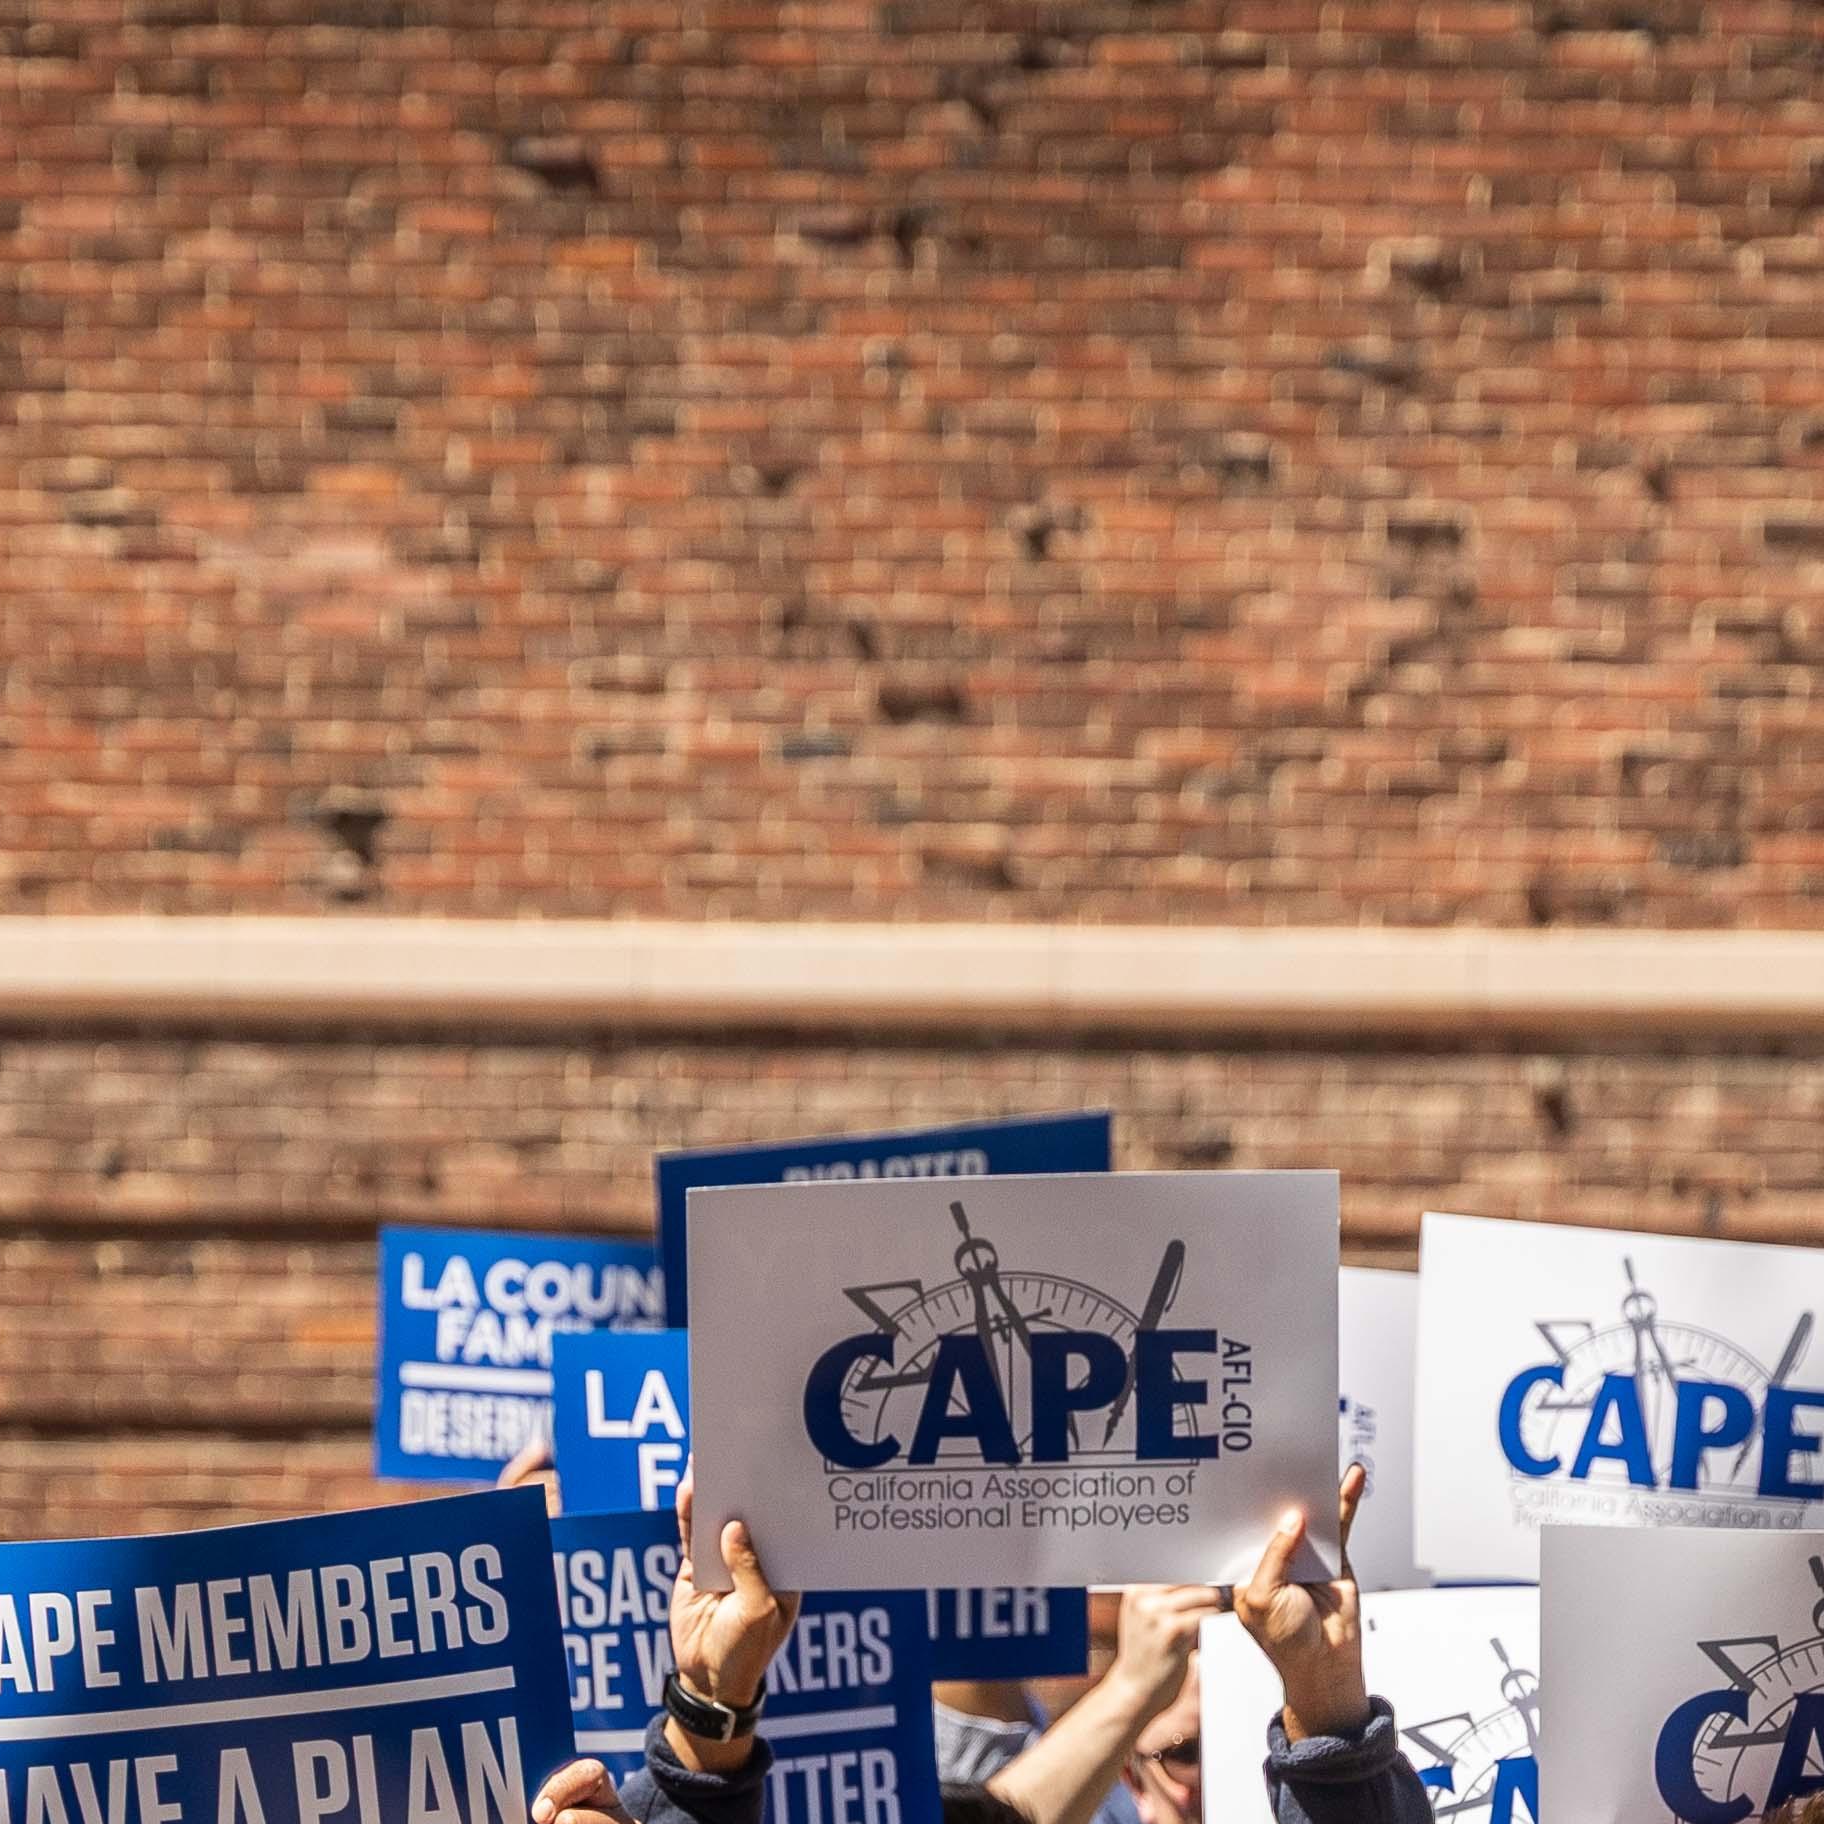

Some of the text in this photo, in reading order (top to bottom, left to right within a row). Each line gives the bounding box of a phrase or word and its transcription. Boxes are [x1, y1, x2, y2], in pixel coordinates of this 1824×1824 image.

[402, 1252, 667, 1319] LA COUN
[585, 1370, 686, 1438] LA
[804, 1329, 1219, 1470] CAPE
[1221, 1337, 1251, 1452] AFL-CIO
[827, 1469, 1196, 1503] California Association of
[835, 1501, 1190, 1531] Professional Employees
[135, 1544, 509, 1683] MEMBERS
